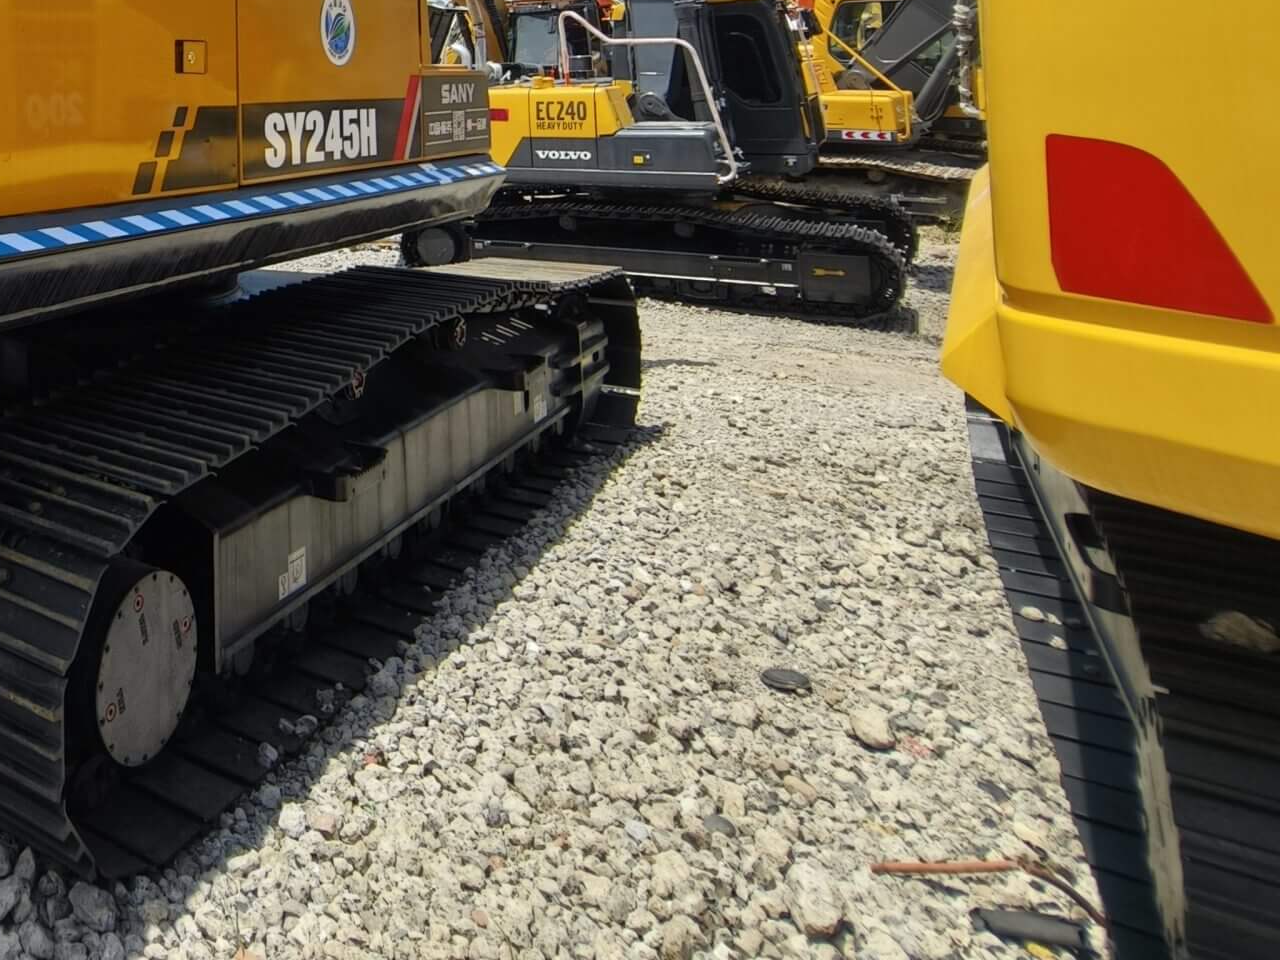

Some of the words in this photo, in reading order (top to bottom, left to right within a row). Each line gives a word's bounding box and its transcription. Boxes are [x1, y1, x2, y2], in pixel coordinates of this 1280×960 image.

[441, 83, 475, 104] SANY
[535, 100, 588, 121] EC240
[536, 122, 561, 130] HEAVY
[562, 121, 584, 130] DUTY
[264, 107, 378, 169] SY245H
[535, 150, 592, 160] VOLVO
